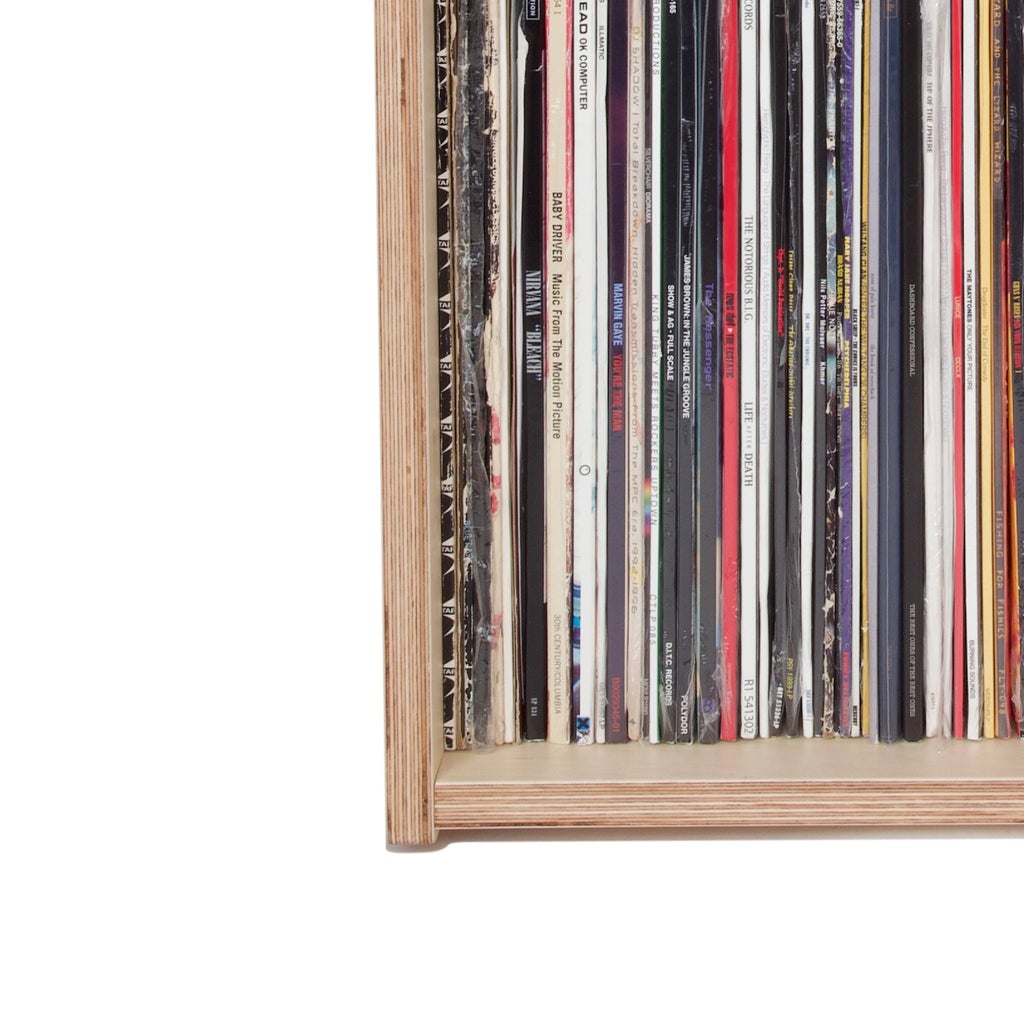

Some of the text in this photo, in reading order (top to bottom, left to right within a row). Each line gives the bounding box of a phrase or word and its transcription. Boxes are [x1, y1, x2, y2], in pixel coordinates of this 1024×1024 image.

[579, 38, 588, 52] OK
[993, 38, 1001, 59] AND
[579, 54, 588, 110] COMPUTER
[993, 67, 1001, 88] THE
[993, 95, 1001, 131] LIZARD
[993, 142, 1001, 183] WIZARD
[744, 215, 754, 235] THE
[744, 237, 754, 295] NOTORIOUS
[525, 270, 542, 316] NIRVANA
[667, 285, 675, 309] SHOW
[819, 279, 827, 293] Nils
[743, 297, 754, 324] B.I.G.
[819, 294, 827, 318] Petter
[843, 286, 851, 319] HOOPER
[908, 284, 916, 326] DASHBOARD
[667, 317, 675, 329] AG
[682, 254, 691, 419] JAMES BROWN: IN THE JUNGLE GROOVE
[818, 319, 826, 349] Molvaer
[612, 283, 623, 431] MARVIN GAYE YOU'RE THE MAN
[666, 334, 674, 354] FULL
[666, 355, 674, 381] SCALE
[744, 401, 753, 423] LIFE
[551, 192, 563, 714] BABY DRIVER Music From The Motion Picture 30th CENTURY/COLUMBIA
[744, 453, 753, 487] DEATH
[909, 655, 916, 664] OF
[744, 679, 754, 692] R1
[680, 695, 688, 734] POLYDOR
[744, 695, 754, 734] 541302
